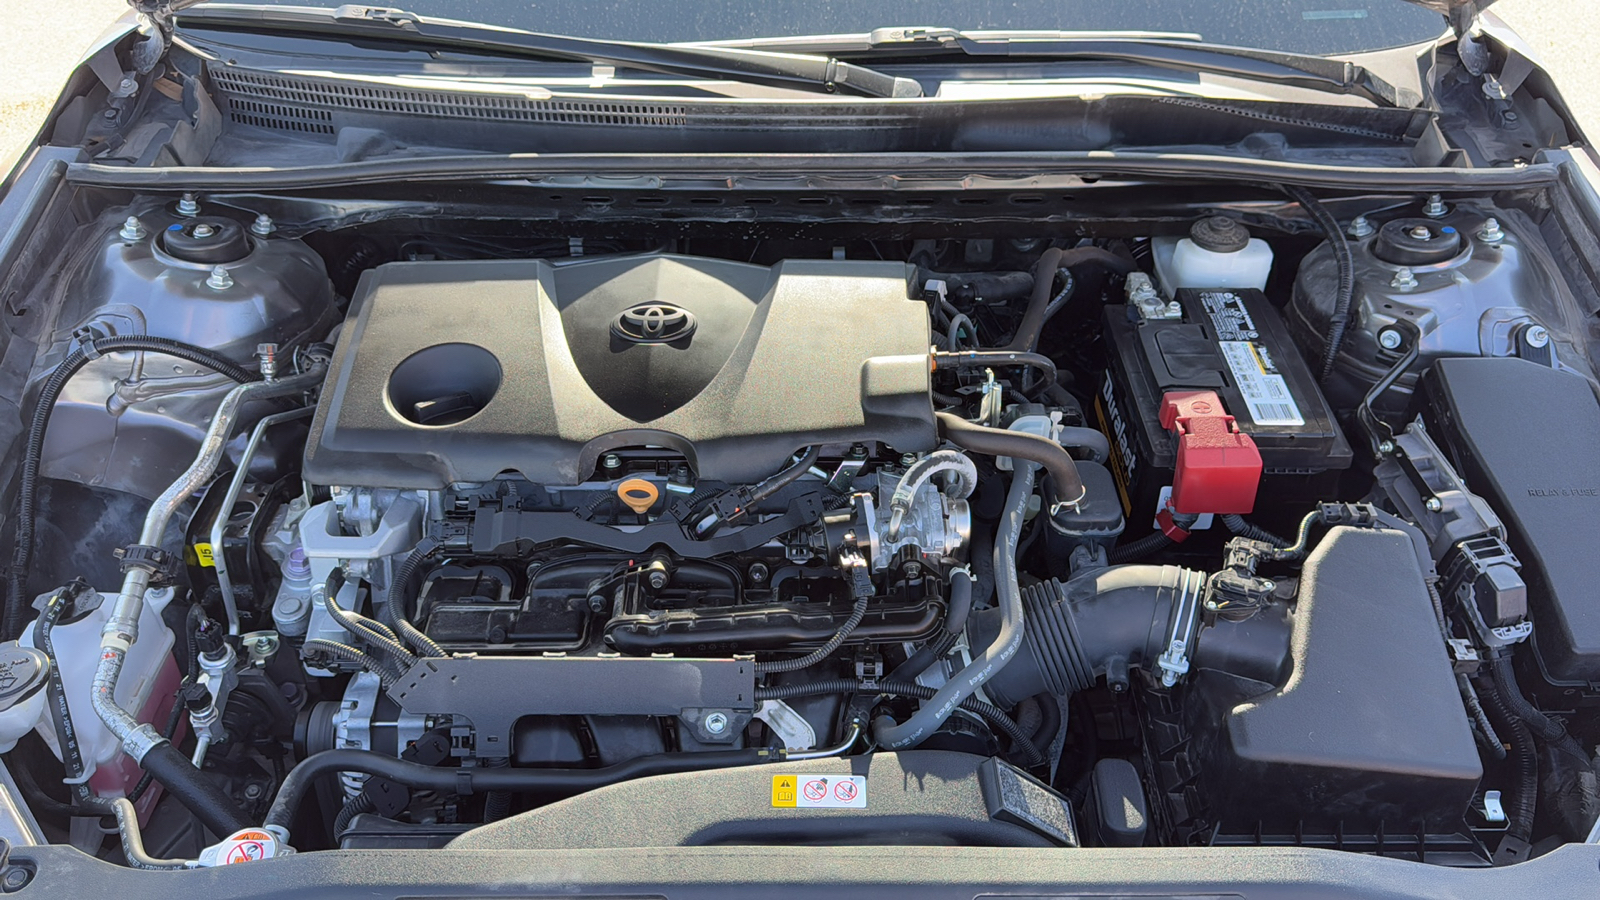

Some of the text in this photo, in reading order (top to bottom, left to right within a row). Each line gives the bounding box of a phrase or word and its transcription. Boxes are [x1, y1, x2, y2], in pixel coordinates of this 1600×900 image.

[1103, 368, 1135, 479] Duralast
[1527, 488, 1598, 497] RELAY & FUSE
[56, 683, 63, 691] 21
[58, 694, 68, 716] WATER
[73, 762, 80, 771] 21
